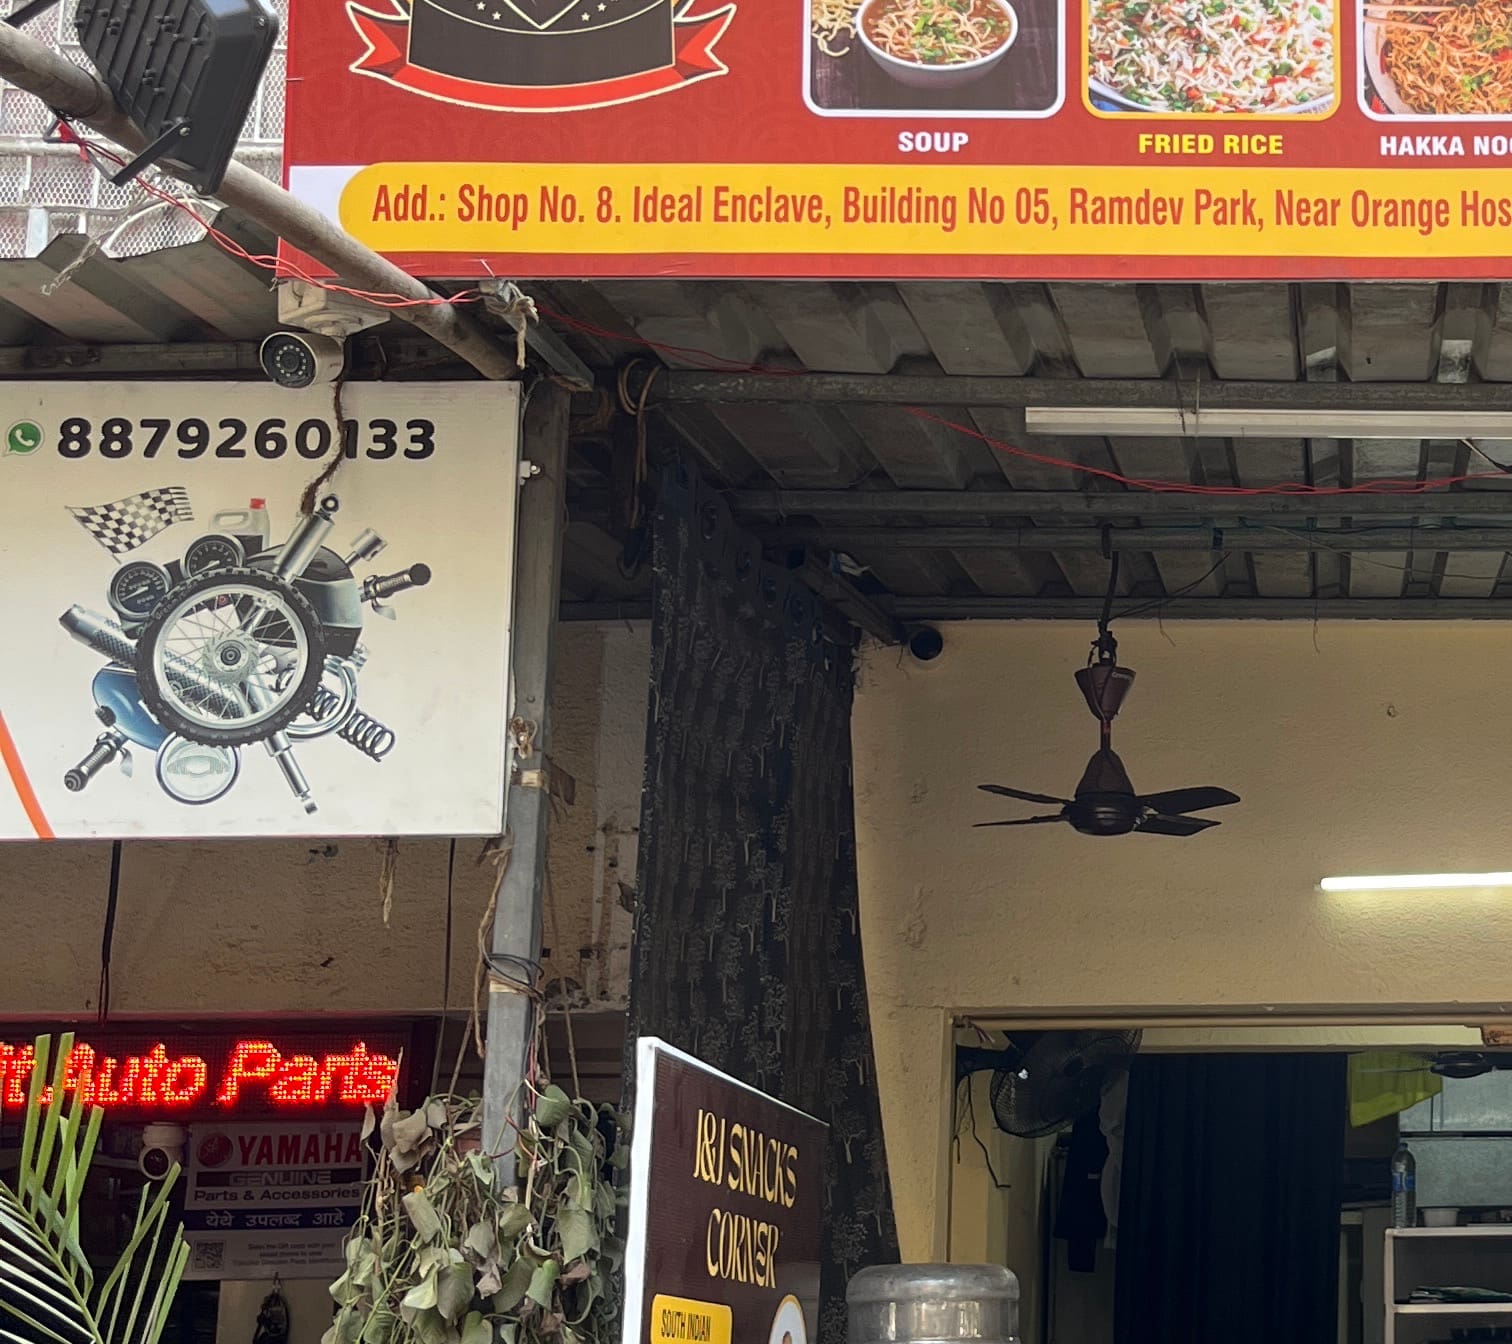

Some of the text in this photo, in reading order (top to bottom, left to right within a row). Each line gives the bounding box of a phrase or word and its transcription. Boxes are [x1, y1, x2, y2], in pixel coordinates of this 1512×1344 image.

[899, 132, 968, 152] SOUP
[1139, 134, 1282, 154] FRIED RICE
[1381, 136, 1464, 155] HAKKA
[373, 185, 445, 221] Add.:
[458, 184, 528, 230] Shop
[540, 186, 584, 222] No.
[634, 186, 701, 222] Ideal
[714, 186, 830, 228] Enclave,
[844, 187, 970, 232] Building
[974, 188, 1004, 224] No
[1016, 188, 1057, 229] 05,
[1071, 188, 1183, 225] Ramdev
[1196, 189, 1263, 230] Park,
[1276, 190, 1340, 226] Near
[1352, 190, 1449, 235] Orange
[57, 418, 436, 459] 8879260133
[38, 1042, 207, 1103] Auto
[216, 1040, 397, 1104] Parts
[238, 1132, 363, 1165] YAMAHA
[229, 1170, 331, 1185] GENUINE
[728, 1123, 798, 1208] SNACKS
[194, 1188, 360, 1201] Parts & Accessories
[706, 1208, 779, 1288] CORNER
[661, 1309, 711, 1342] SOUTH INDIAN
